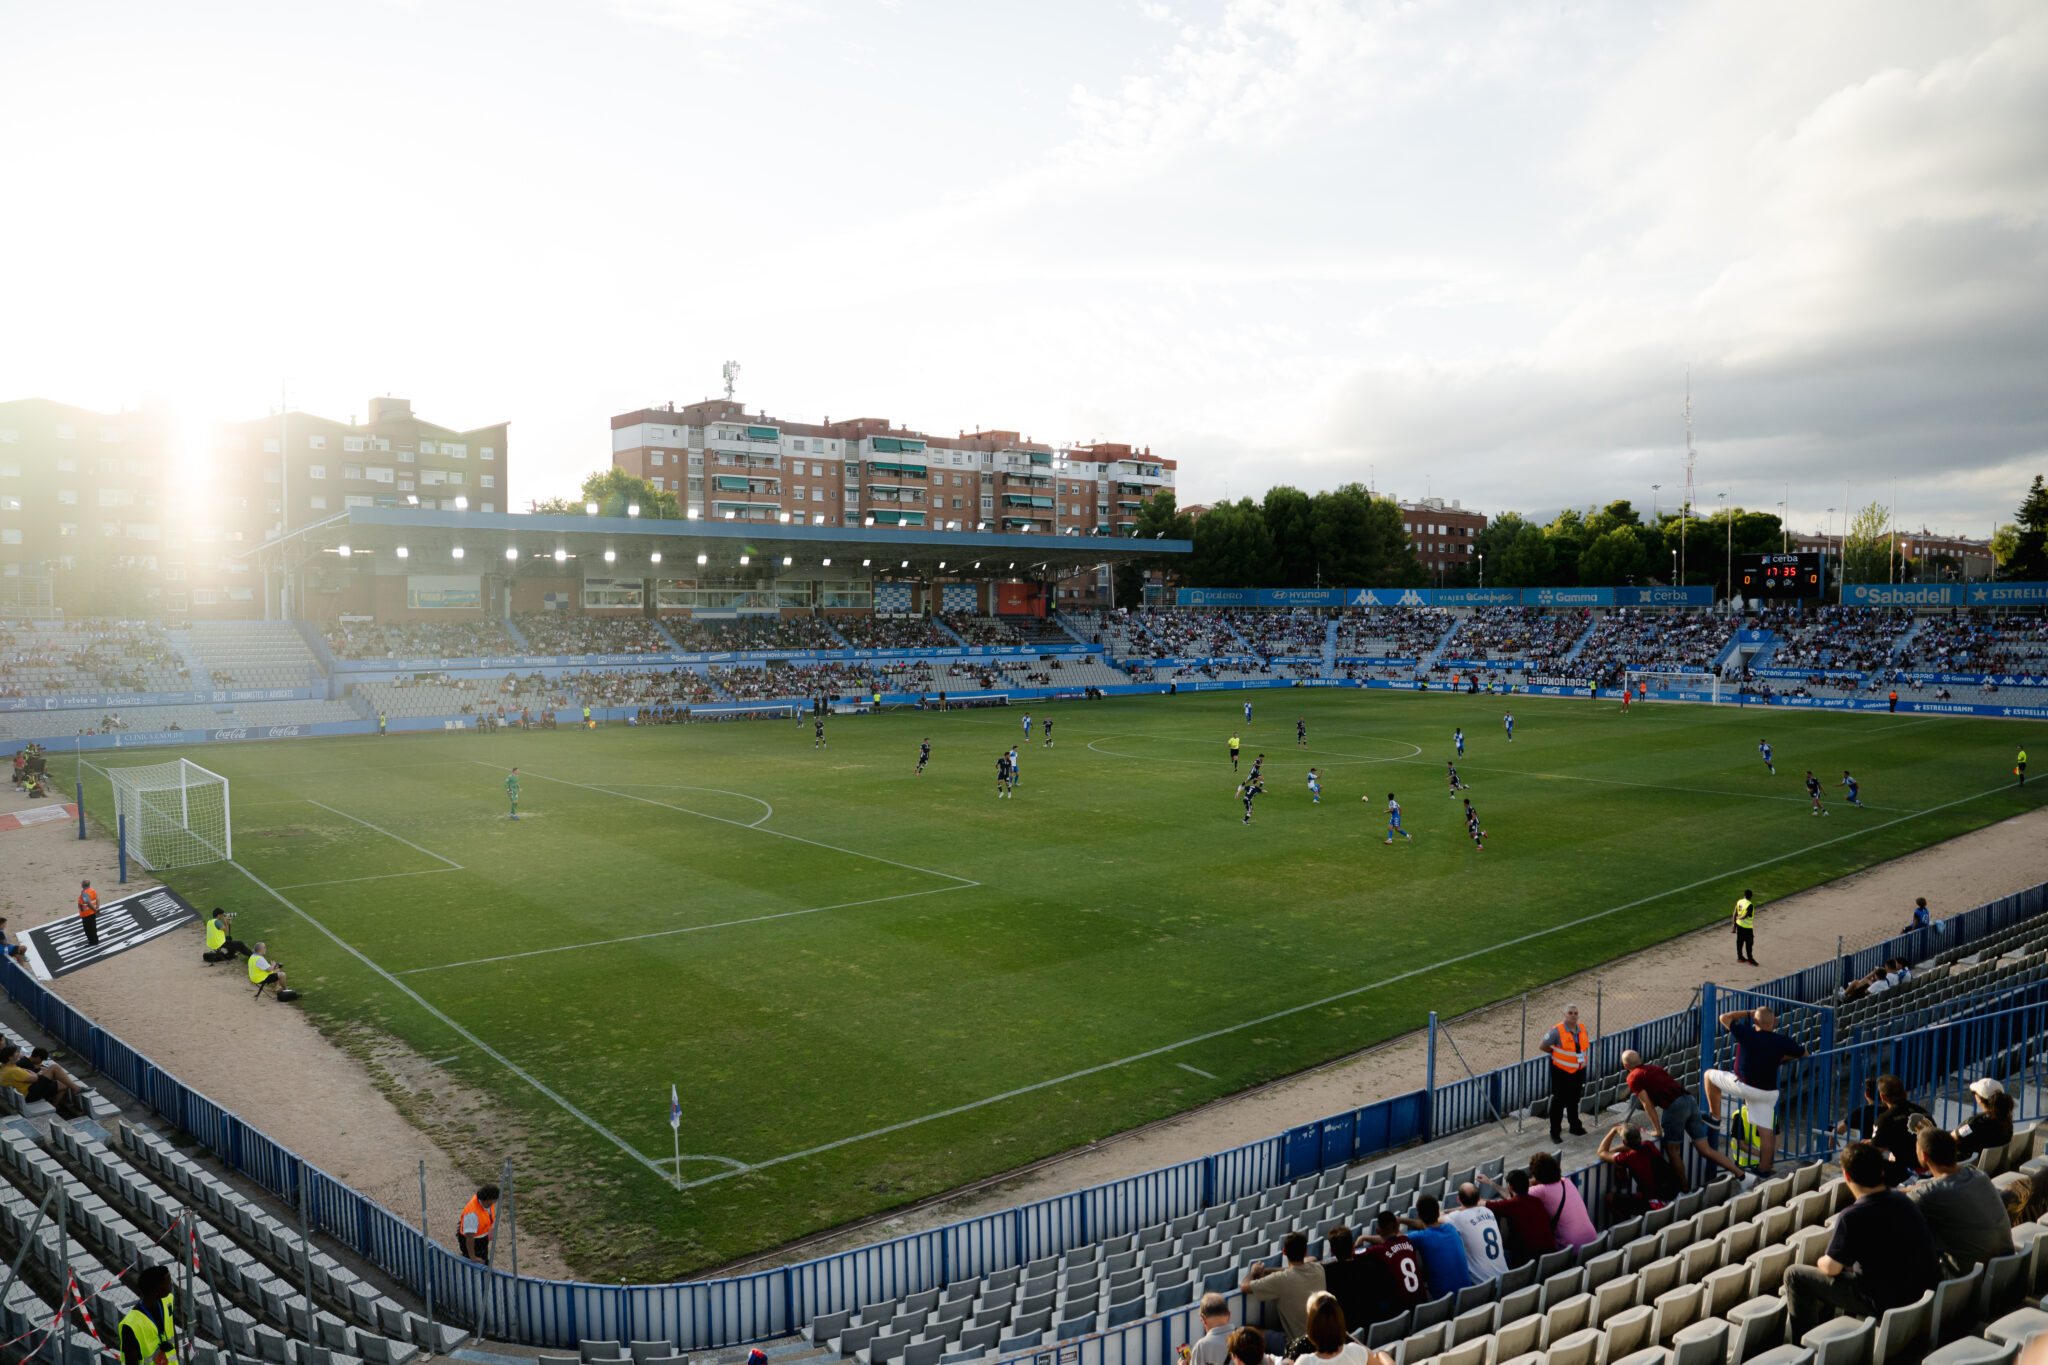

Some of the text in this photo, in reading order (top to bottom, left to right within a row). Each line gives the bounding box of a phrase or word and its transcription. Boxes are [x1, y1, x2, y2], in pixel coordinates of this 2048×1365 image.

[1772, 554, 1799, 563] cerba
[1744, 575, 1751, 585] 0
[1810, 574, 1818, 584] 0
[1556, 592, 1598, 603] Gamma
[1654, 590, 1688, 602] cerba
[1868, 587, 1951, 604] Sabadell
[1536, 676, 1588, 688] HONOR 1903
[1922, 704, 1952, 712] ESTRELLA
[1483, 1227, 1500, 1260] 8
[1400, 1257, 1419, 1292] 8
